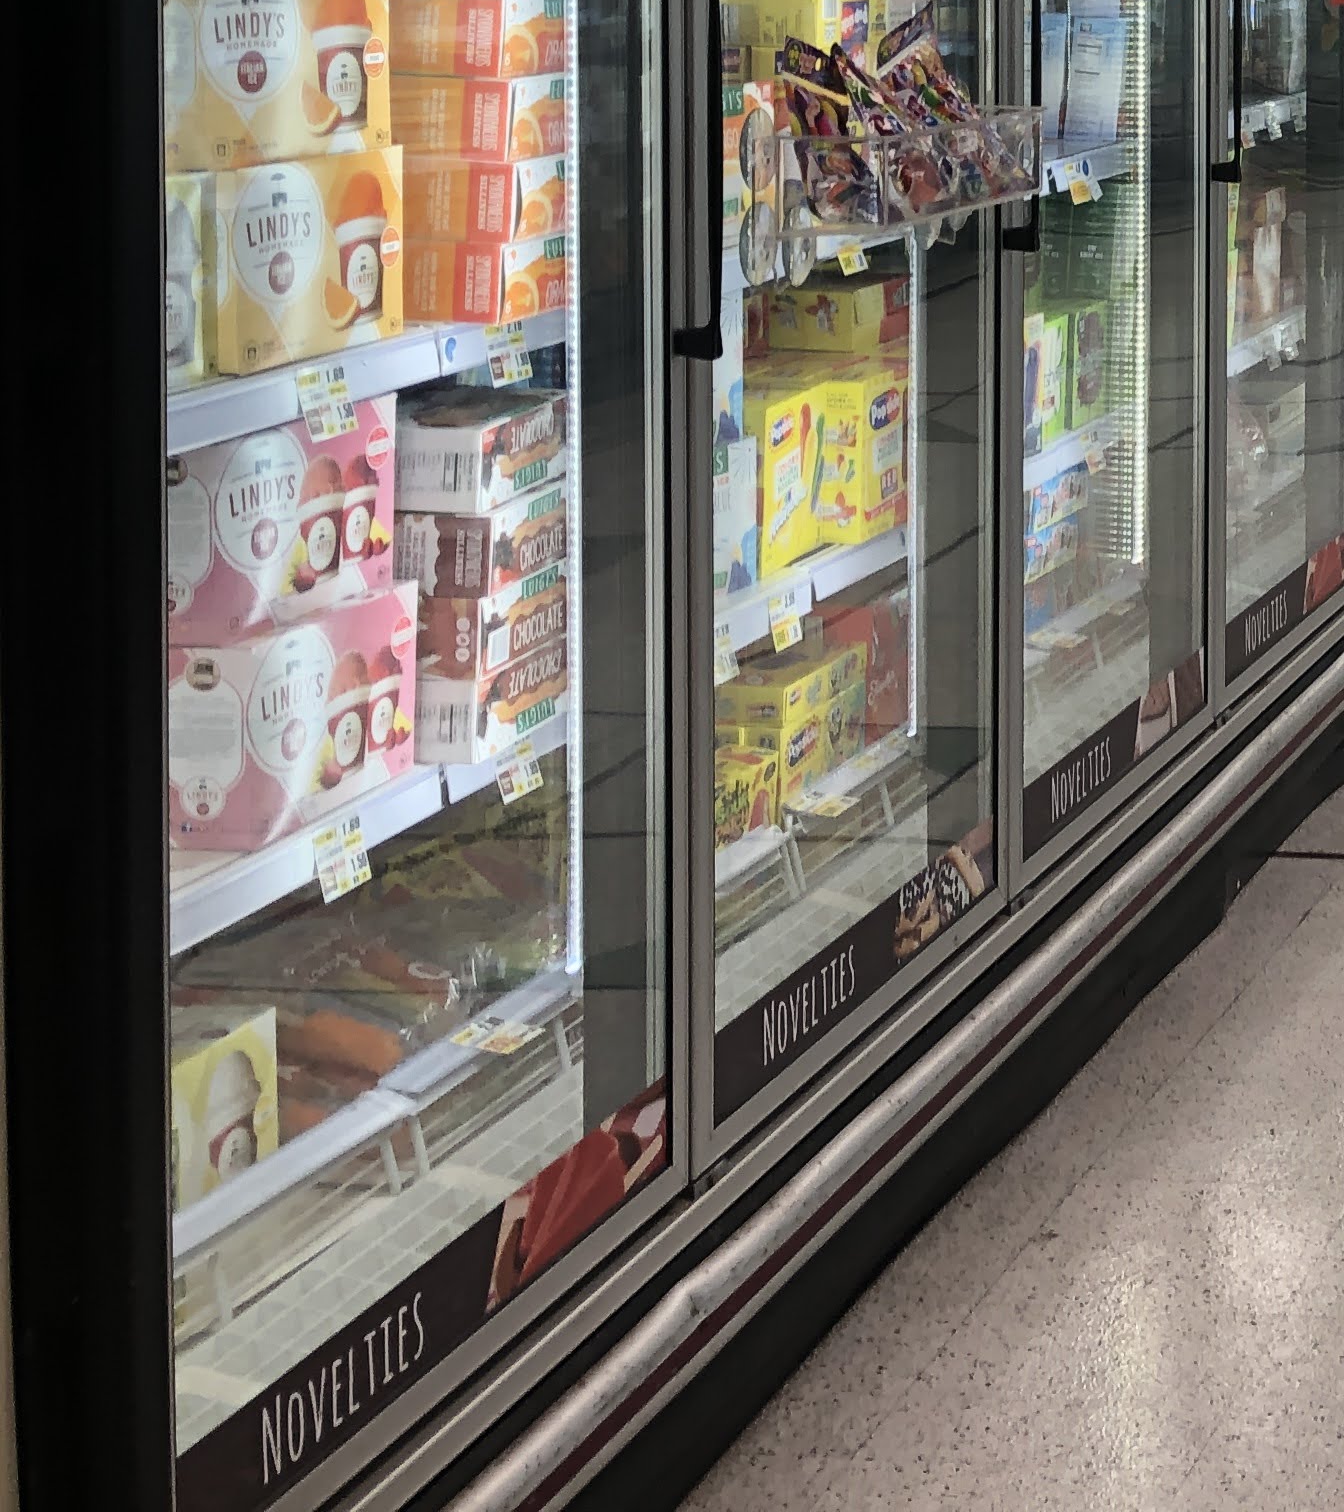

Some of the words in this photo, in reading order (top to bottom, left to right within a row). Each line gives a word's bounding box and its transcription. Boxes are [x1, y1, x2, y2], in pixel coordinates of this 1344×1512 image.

[213, 13, 285, 44] LINDY'S
[246, 211, 311, 248] LINDY'S
[229, 474, 296, 519] LINDY'S
[514, 459, 549, 490] LUIGI'S
[519, 524, 564, 572] CHOCOLATE
[513, 601, 564, 652] CHOCOLATE
[1243, 589, 1289, 657] NOVELTIES
[508, 648, 563, 699] CHOCOLATE
[516, 698, 556, 732] LUIGI'S
[1049, 735, 1113, 824] NOVELTIES
[762, 943, 856, 1067] NOVELTIES
[260, 1291, 426, 1486] NOVELTIES
